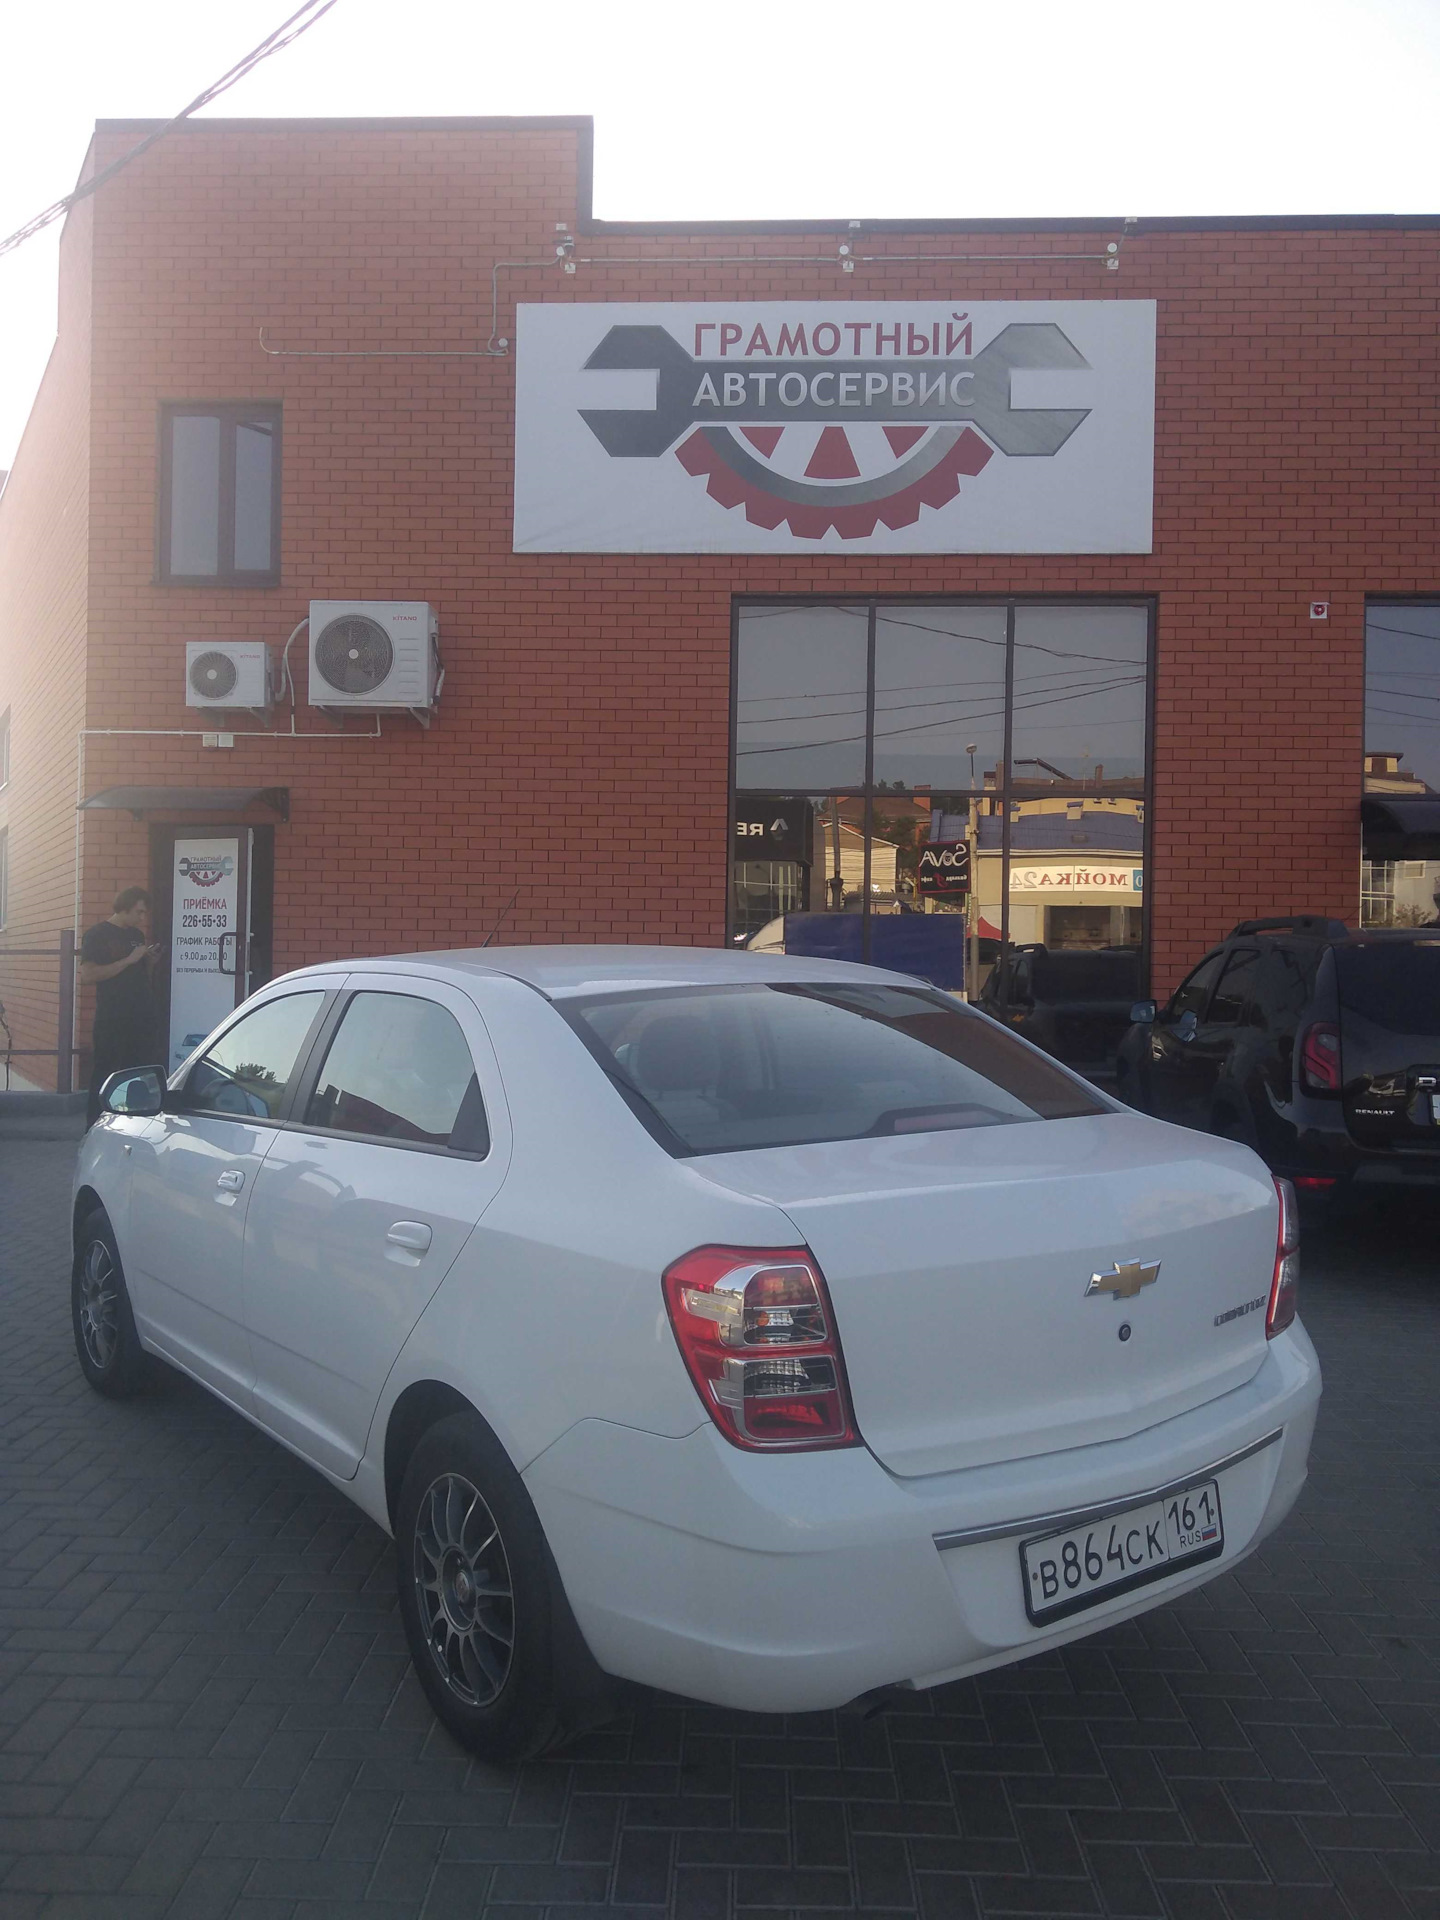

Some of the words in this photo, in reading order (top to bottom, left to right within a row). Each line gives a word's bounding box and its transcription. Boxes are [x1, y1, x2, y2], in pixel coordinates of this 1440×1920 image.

[693, 312, 974, 357] ГРАМОТНЫЙ
[692, 371, 976, 408] АВТОСЕРВИС
[183, 896, 228, 910] ПРИЁМКА
[176, 936, 203, 946] ГРАФИК
[184, 951, 200, 961] 9.00
[208, 951, 228, 961] 20.0
[1355, 1108, 1396, 1116] RENAULT
[1168, 1491, 1212, 1536] 161
[1179, 1530, 1202, 1549] RUS
